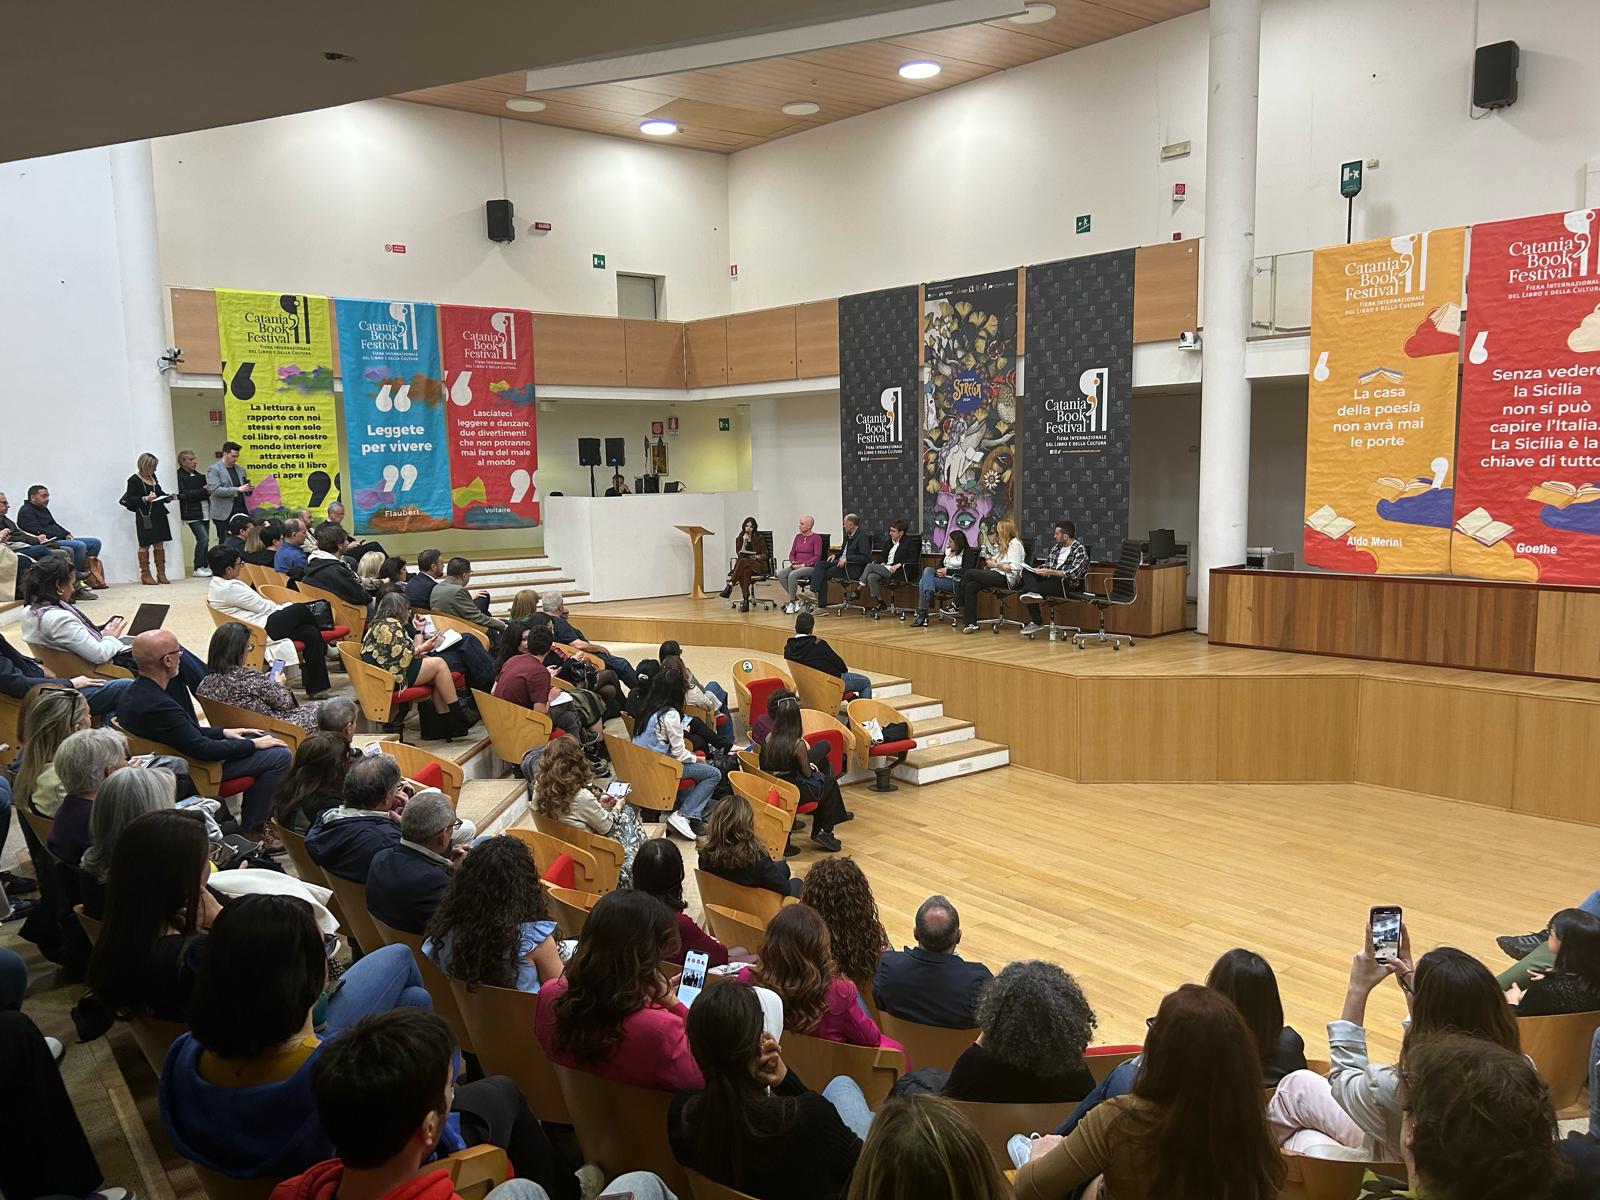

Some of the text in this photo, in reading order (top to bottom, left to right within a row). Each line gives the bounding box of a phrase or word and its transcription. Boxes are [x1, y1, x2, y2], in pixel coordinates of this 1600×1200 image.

[1509, 236, 1574, 256] Catania
[1527, 250, 1572, 268] Book
[1345, 258, 1399, 276] Catania
[1509, 260, 1572, 284] Festival
[1360, 270, 1398, 286] Book
[1346, 280, 1398, 300] Festival
[244, 312, 288, 324] Catania
[259, 323, 288, 334] Book
[358, 321, 398, 332] Catania
[247, 332, 290, 344] Festival
[371, 331, 398, 340] Book
[463, 331, 498, 342] Catania
[361, 340, 399, 350] Festival
[474, 340, 498, 350] Book
[464, 348, 500, 359] Festival
[1492, 369, 1542, 381] Senza
[1354, 388, 1406, 400] La casa
[1514, 383, 1582, 398] la Sicilia
[1045, 398, 1086, 411] Catania
[1337, 402, 1420, 416] della poesia
[1502, 400, 1592, 416] non si può
[856, 412, 887, 424] Catania
[1057, 410, 1086, 422] Book
[458, 419, 488, 428] leggere
[497, 420, 530, 428] danzare,
[865, 422, 887, 434] Book
[1046, 420, 1086, 434] Festival
[1334, 417, 1424, 432] non avrà mai
[1490, 420, 1542, 434] capire
[258, 433, 281, 441] libro,
[367, 424, 424, 438] Leggete
[857, 431, 888, 444] Festival
[1351, 436, 1405, 448] le porte
[1491, 436, 1598, 450] La Sicilia è la
[362, 440, 432, 456] per vivere
[494, 440, 530, 448] potranno
[1480, 454, 1600, 468] chiave di tutto
[384, 508, 420, 517] Flaubert
[1346, 536, 1402, 547] Aldo Merini
[1516, 542, 1558, 554] Goethe
